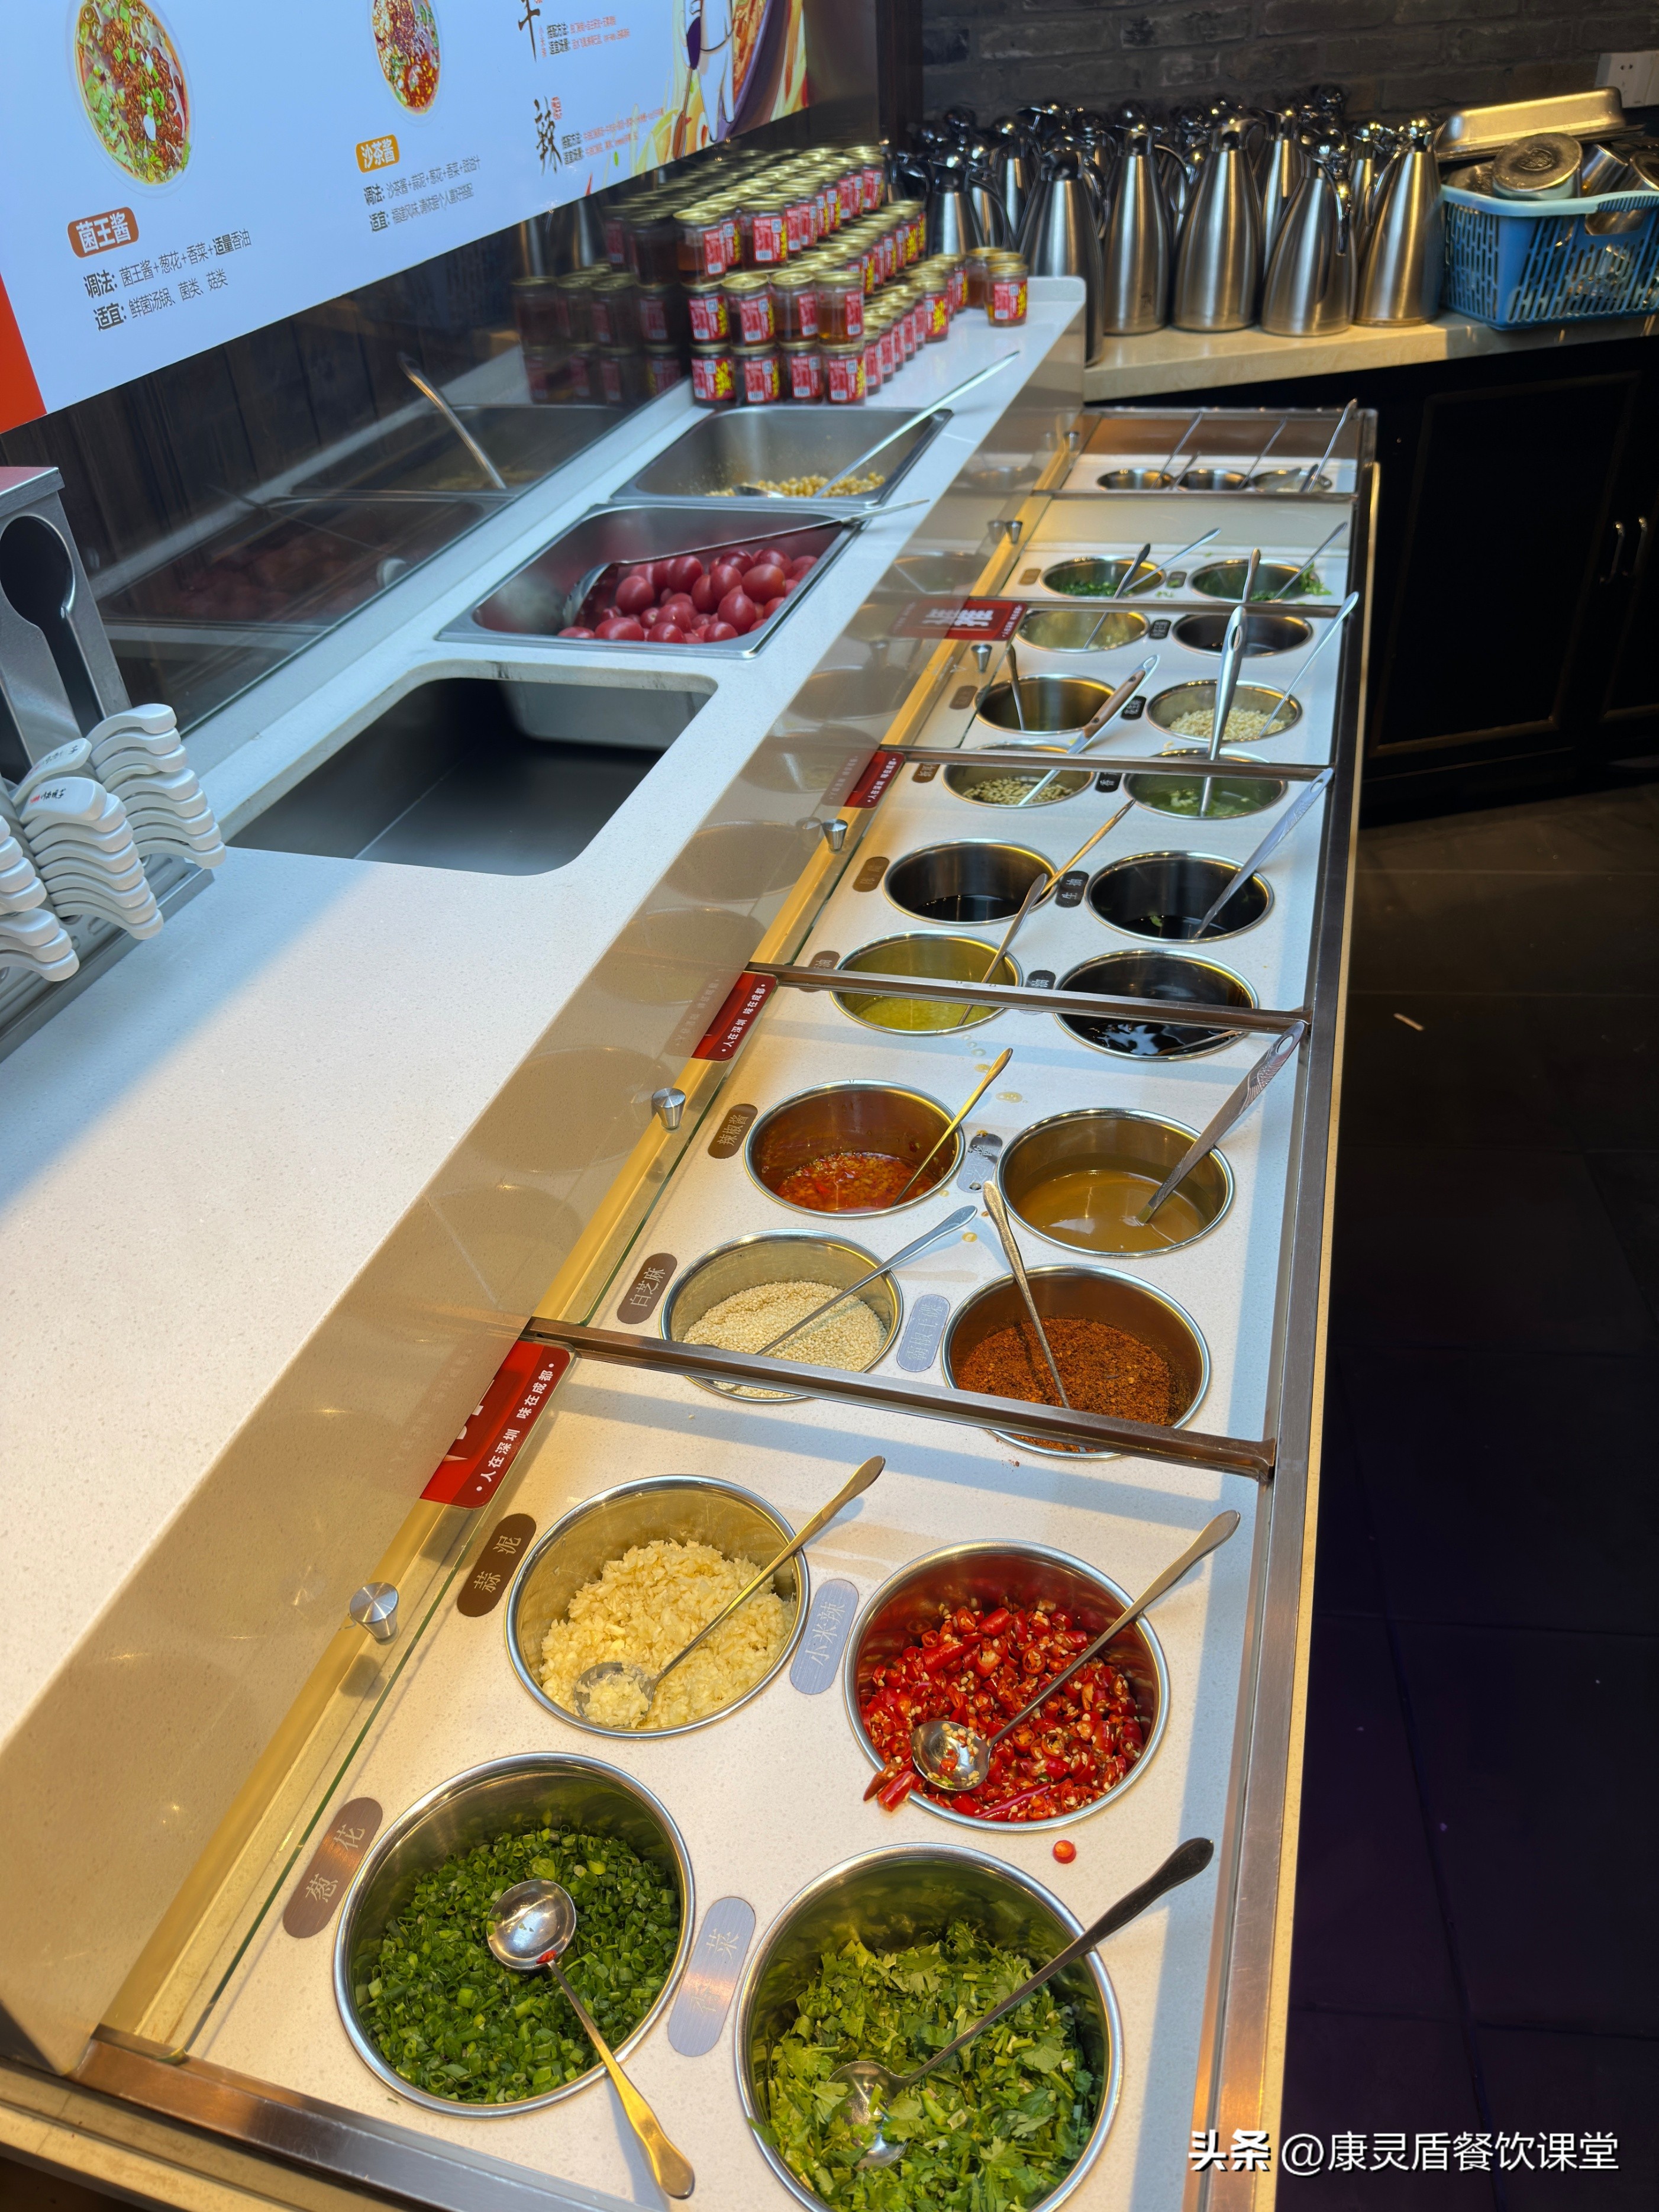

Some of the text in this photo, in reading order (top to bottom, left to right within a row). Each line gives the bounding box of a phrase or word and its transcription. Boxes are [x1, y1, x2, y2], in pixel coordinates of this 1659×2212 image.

[360, 138, 395, 169] 沙茶酱
[76, 212, 131, 253] 菌王酱
[1061, 879, 1083, 899] 生抽
[723, 988, 766, 1047] 人在深圳 味在成都
[717, 1115, 748, 1146] 辣椒酱
[630, 1268, 665, 1307] 白芝麻
[480, 1369, 554, 1482] 人在深圳 味在成都
[473, 1535, 522, 1593] 蒜泥
[805, 1601, 845, 1666] 小米辣
[305, 1824, 365, 1903] 葱花
[690, 1927, 740, 2014] 香菜
